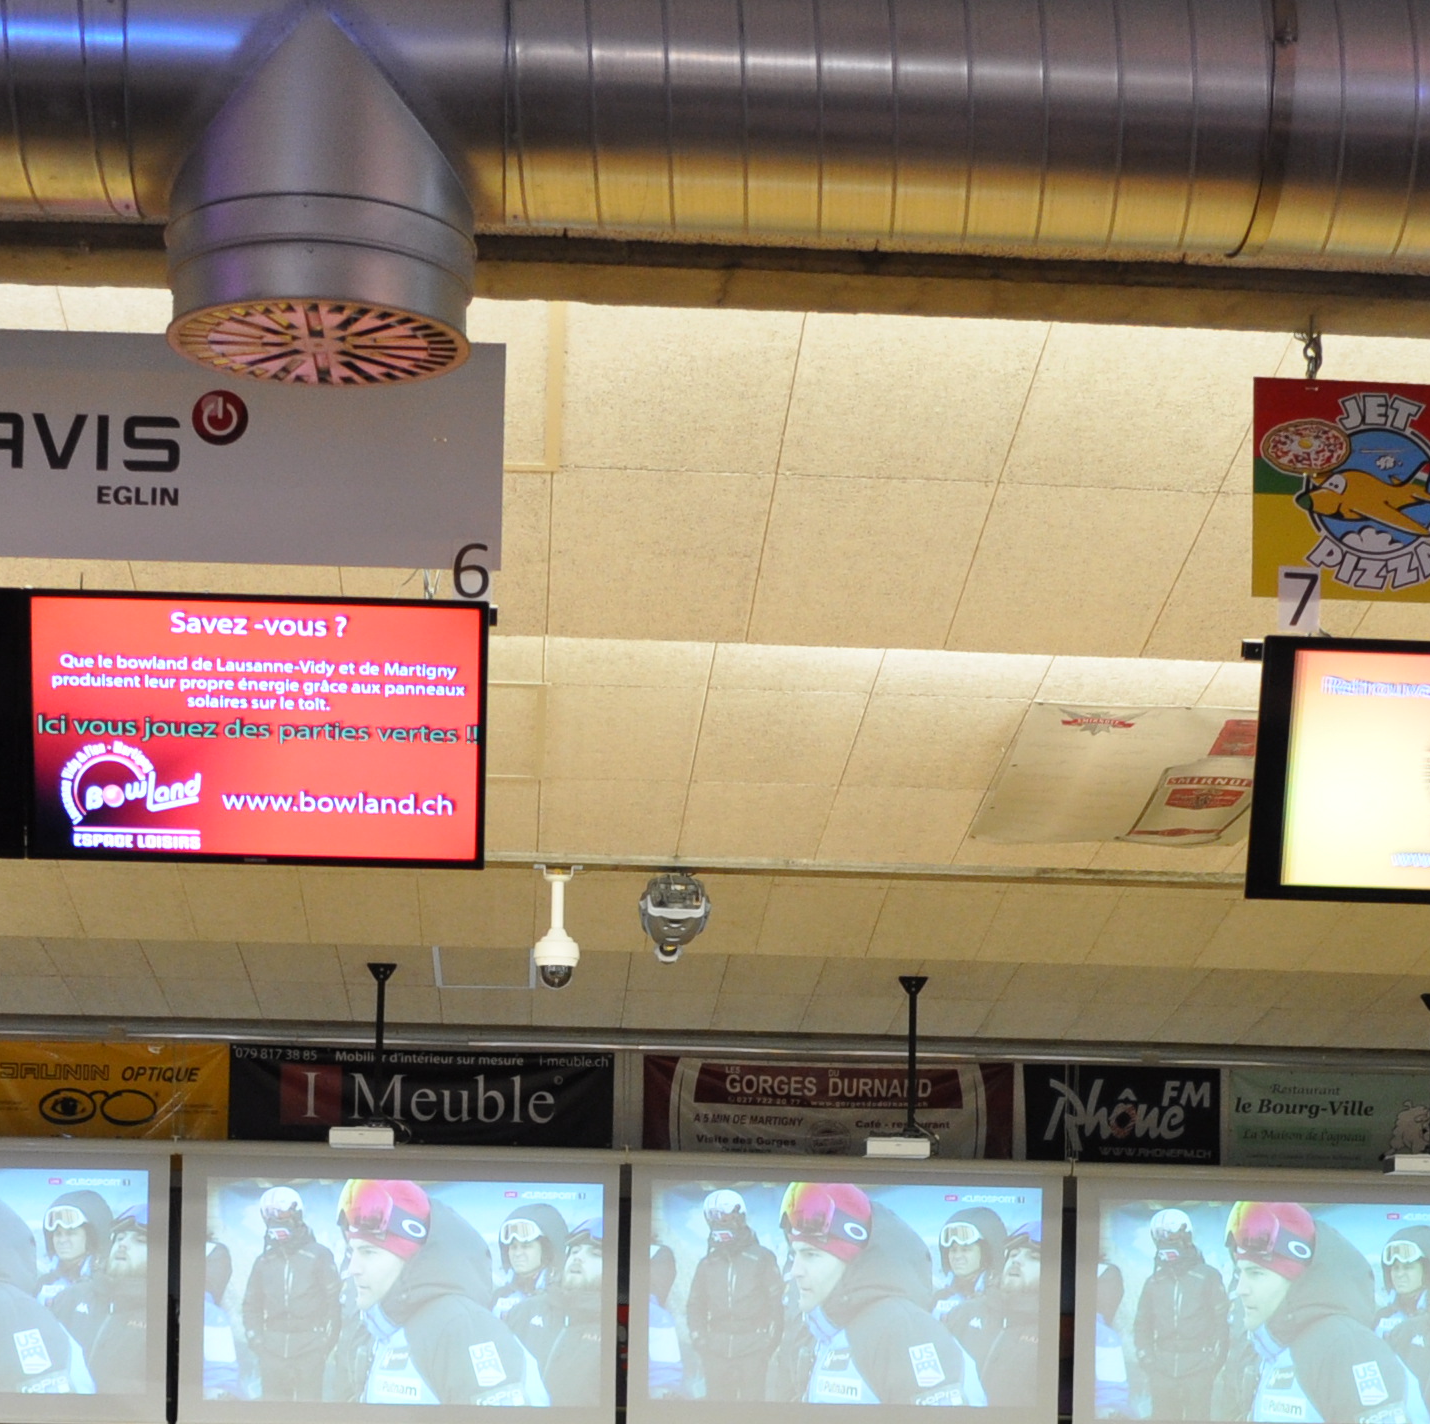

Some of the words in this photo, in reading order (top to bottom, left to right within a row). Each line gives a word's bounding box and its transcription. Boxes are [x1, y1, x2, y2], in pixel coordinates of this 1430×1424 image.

[1337, 394, 1425, 430] JET
[96, 485, 180, 508] EGLIN
[453, 543, 490, 599] 6
[1283, 571, 1319, 627] 7
[170, 611, 247, 635] Savez
[254, 619, 327, 637] -vous
[60, 653, 93, 670] Que
[98, 654, 112, 669] le
[117, 655, 187, 671] bowland
[192, 657, 212, 672] de
[217, 658, 335, 678] Lausanne-Vidy
[340, 662, 355, 676] et
[359, 661, 380, 677] de
[385, 662, 456, 680] Martigny
[52, 673, 140, 689] produisent
[145, 675, 175, 689] leur
[180, 680, 235, 694] propre
[238, 677, 299, 696] énergie
[303, 679, 347, 697] grâce
[352, 683, 380, 695] aux
[385, 683, 465, 698] panneaux
[187, 696, 247, 710] solaires
[251, 698, 276, 710] sur
[280, 696, 294, 710] le
[298, 697, 330, 711] toit.
[38, 715, 66, 736] Ici
[72, 719, 136, 737] vous
[142, 717, 217, 742] jouez
[225, 719, 270, 739] des
[279, 723, 369, 745] parties
[377, 726, 456, 744] vertes
[221, 791, 453, 816] www.bowland.ch
[73, 834, 133, 849] ESPACE
[138, 834, 201, 850] LOISIRS
[235, 1047, 257, 1060] 079
[259, 1048, 282, 1061] 817
[285, 1049, 300, 1061] 38
[303, 1049, 317, 1061] 85
[478, 1056, 524, 1066] mesure
[539, 1055, 609, 1068] i-meuble.ch
[121, 1066, 200, 1083] OPTIQUE
[725, 1074, 817, 1097] GORGES
[350, 1072, 556, 1124] Meuble
[1271, 1083, 1340, 1097] Restaurant
[750, 1115, 803, 1126] MARTIGNY
[1044, 1078, 1186, 1151] Rhône
[1162, 1080, 1211, 1108] FM
[1256, 1100, 1374, 1119] Bourg-Ville
[1099, 1145, 1212, 1160] WWW.RHONEFM.CH
